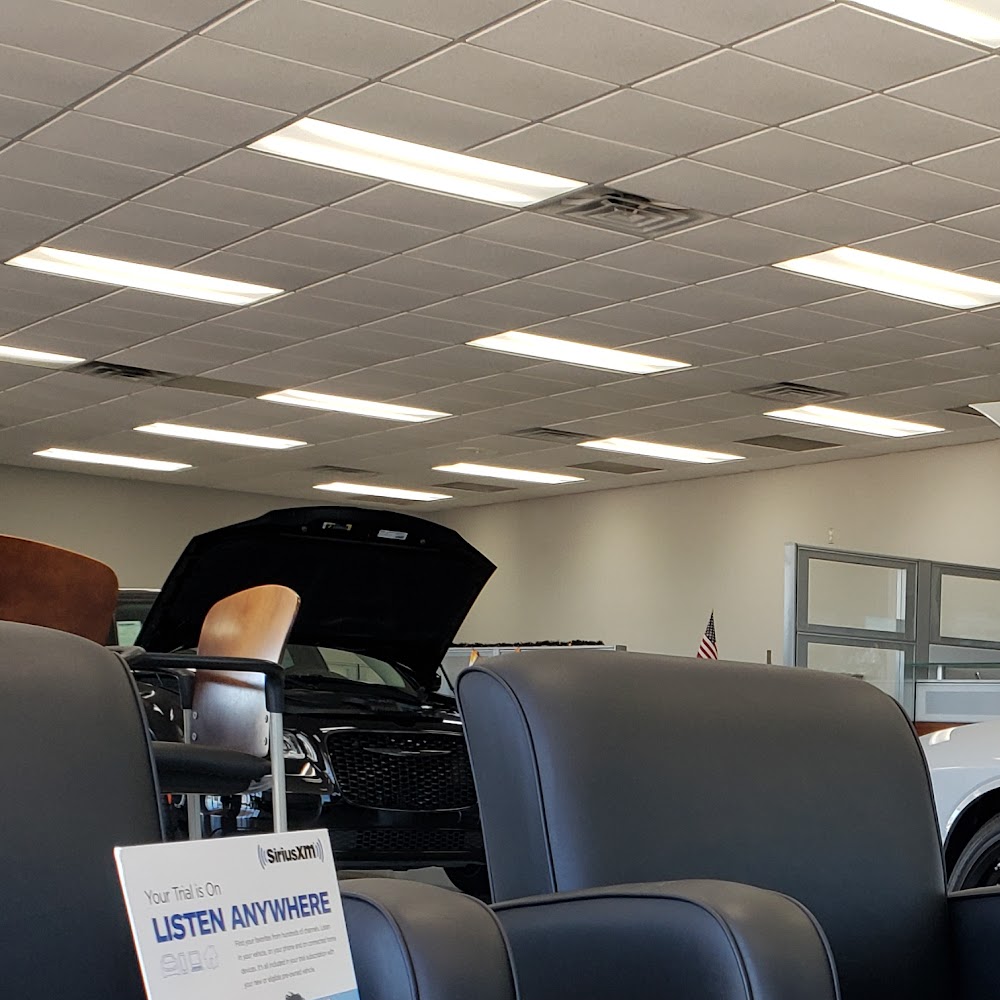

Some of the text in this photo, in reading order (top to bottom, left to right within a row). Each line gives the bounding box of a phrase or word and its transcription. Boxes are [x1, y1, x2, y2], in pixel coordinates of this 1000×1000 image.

[145, 882, 221, 906] Your Trial is On
[152, 892, 331, 943] LISTEN ANYWHERE
